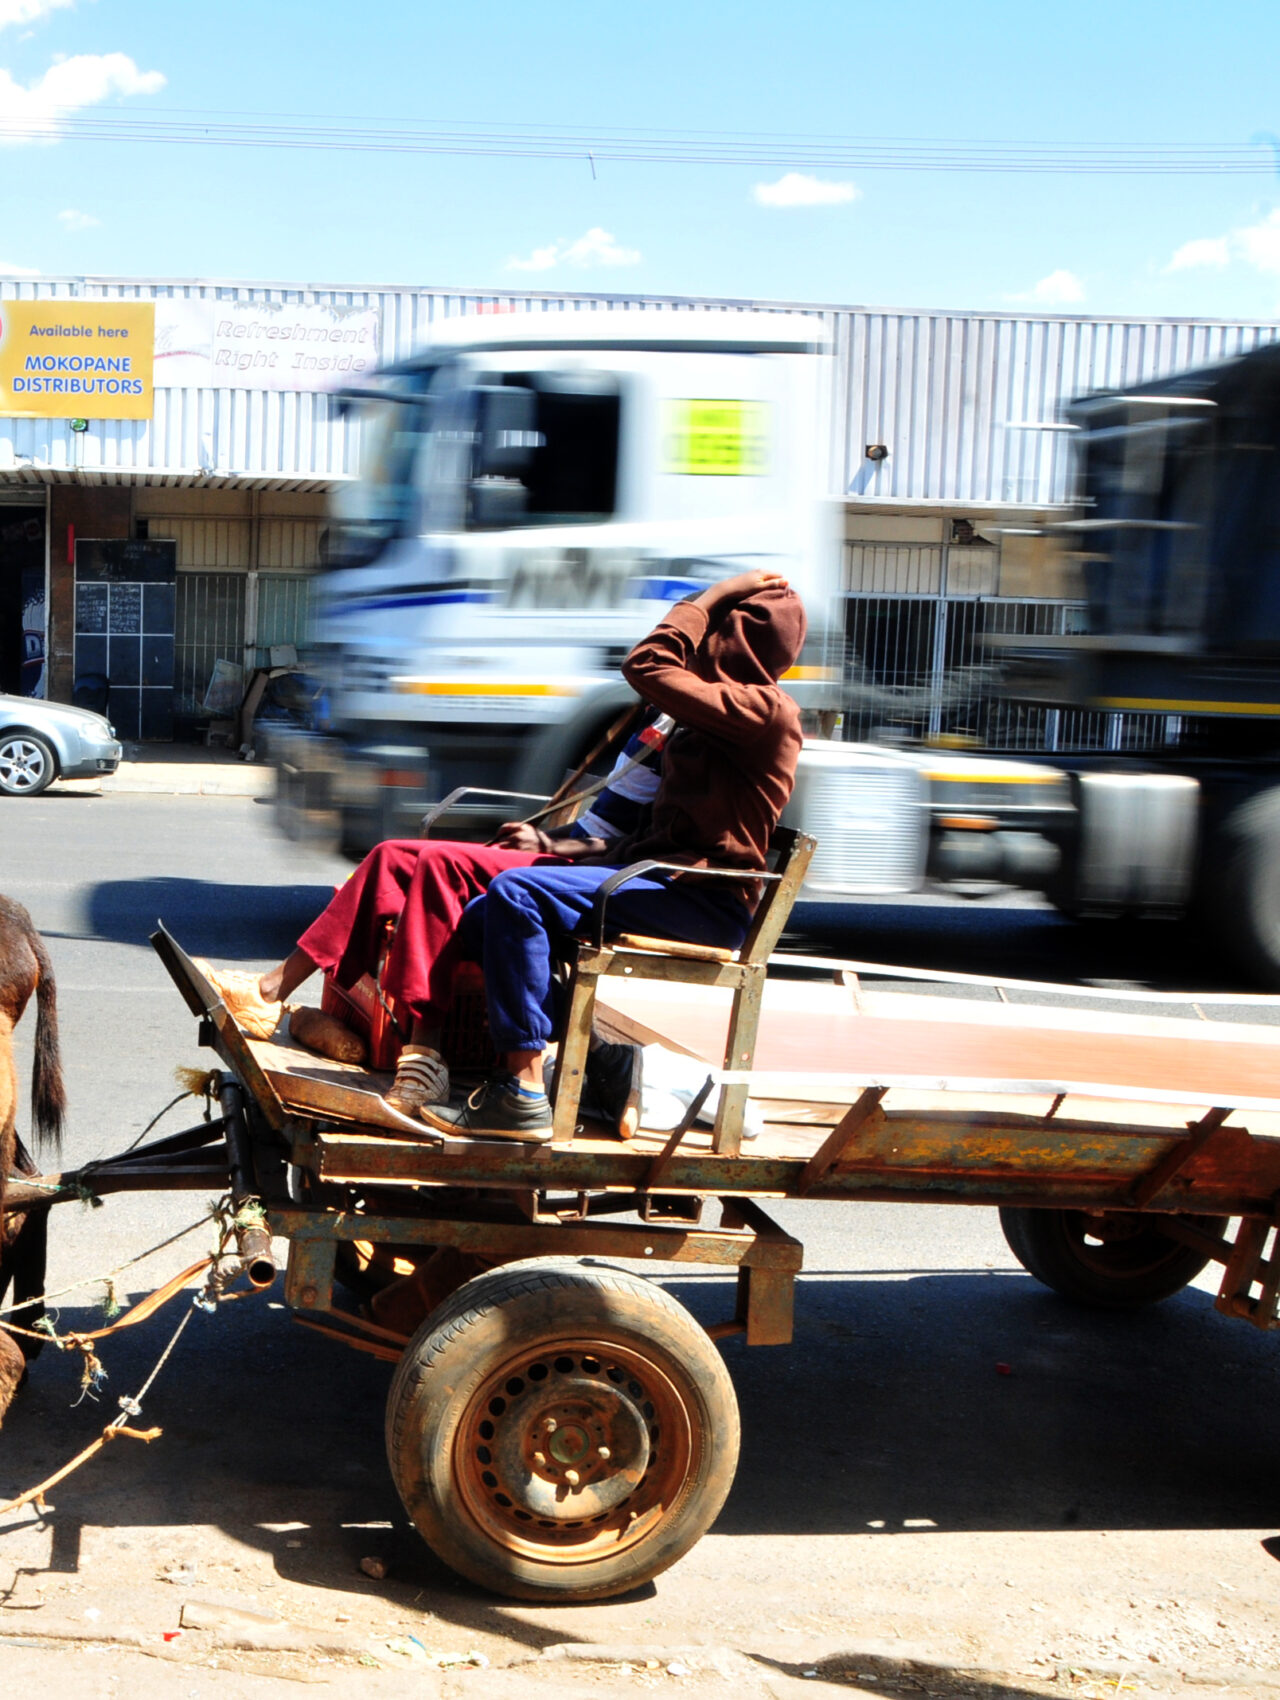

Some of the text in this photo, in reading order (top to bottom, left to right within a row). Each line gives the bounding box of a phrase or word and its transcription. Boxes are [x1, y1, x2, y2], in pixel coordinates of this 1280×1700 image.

[29, 324, 129, 339] Available here
[216, 320, 368, 345] Refreshment
[25, 355, 132, 373] MOKOPANE
[214, 349, 367, 373] Right Inside
[12, 377, 144, 395] DISTRIBUTORS
